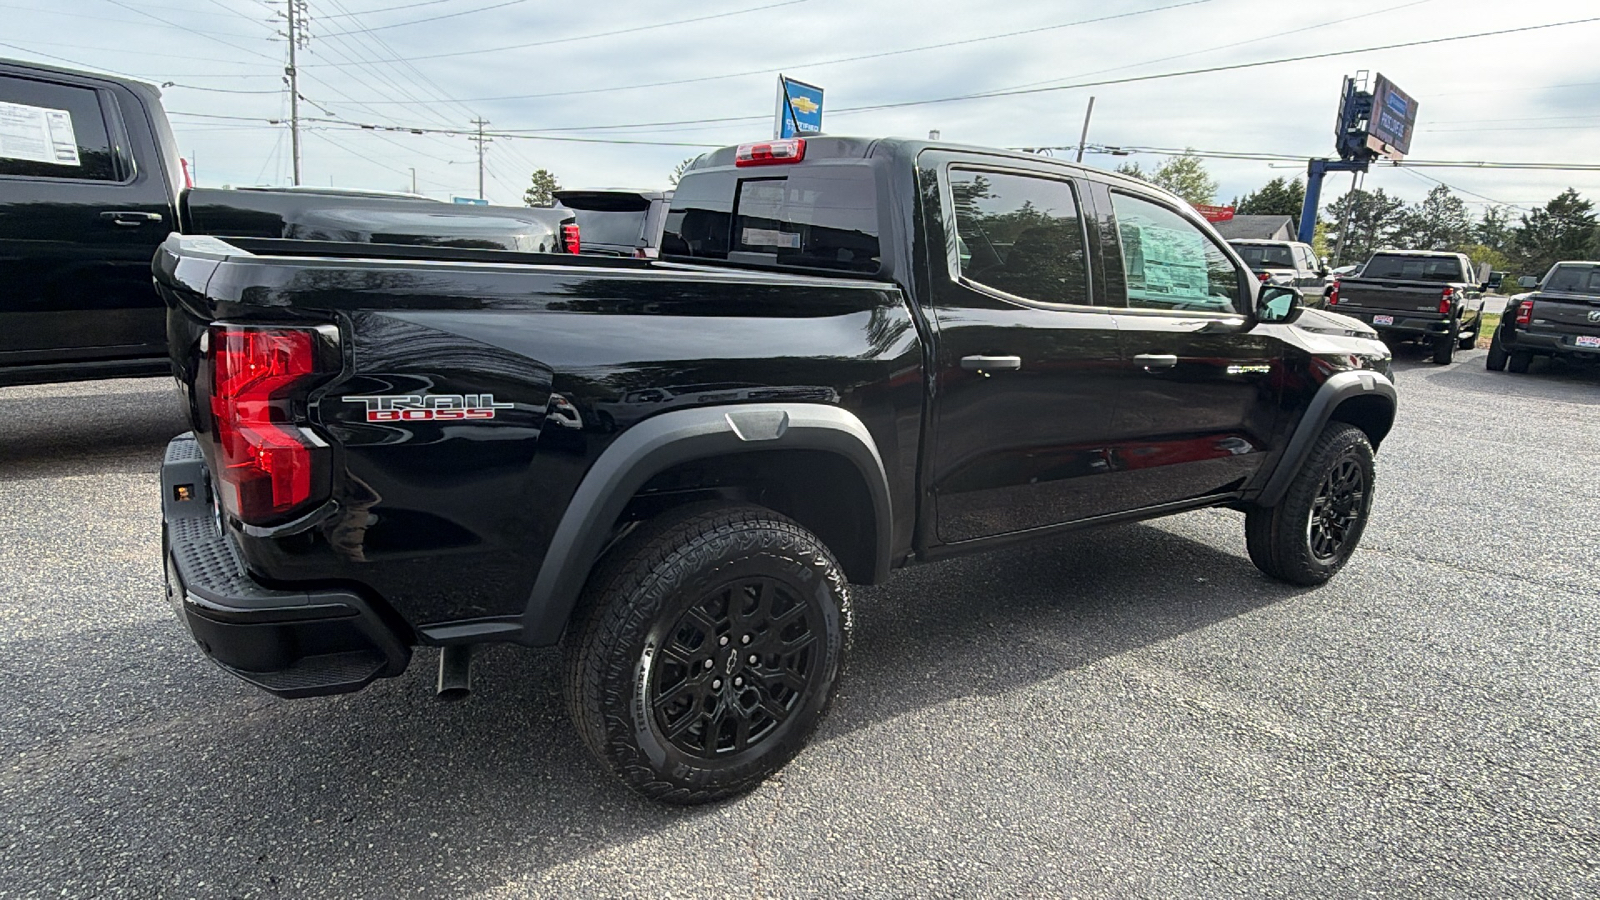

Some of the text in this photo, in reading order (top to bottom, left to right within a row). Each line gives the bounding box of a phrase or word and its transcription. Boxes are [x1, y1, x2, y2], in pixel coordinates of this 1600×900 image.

[786, 119, 819, 130] CTIFIED
[342, 394, 514, 411] TRAIL
[367, 407, 495, 422] BOSS
